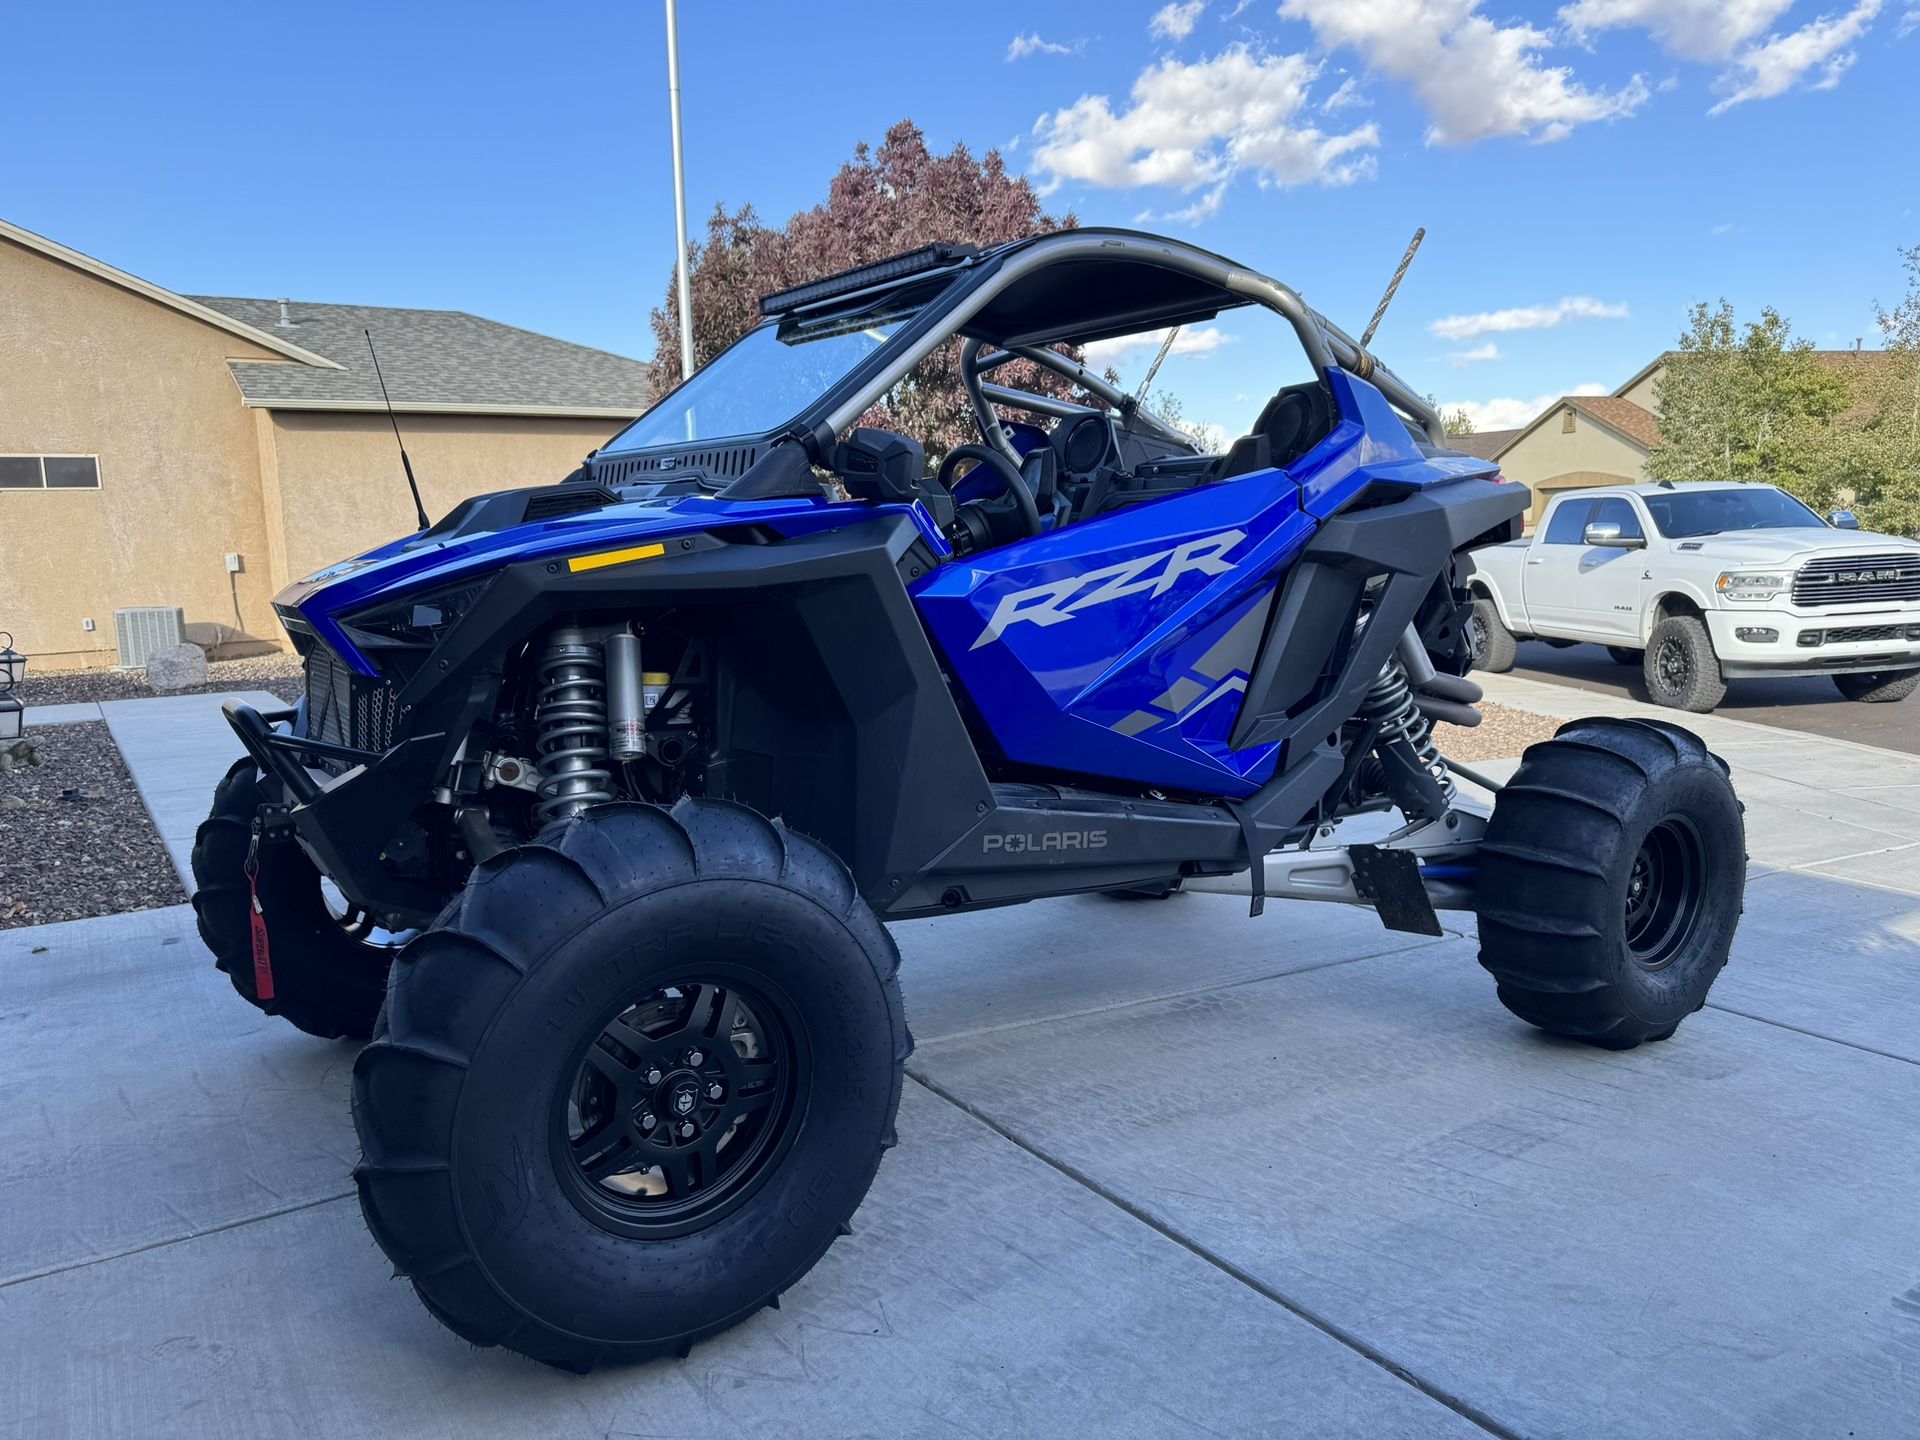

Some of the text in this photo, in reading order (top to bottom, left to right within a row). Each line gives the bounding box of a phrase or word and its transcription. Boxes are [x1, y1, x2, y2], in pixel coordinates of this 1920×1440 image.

[1838, 569, 1896, 582] RAM
[968, 528, 1248, 652] RZR
[982, 830, 1108, 854] POLARIS
